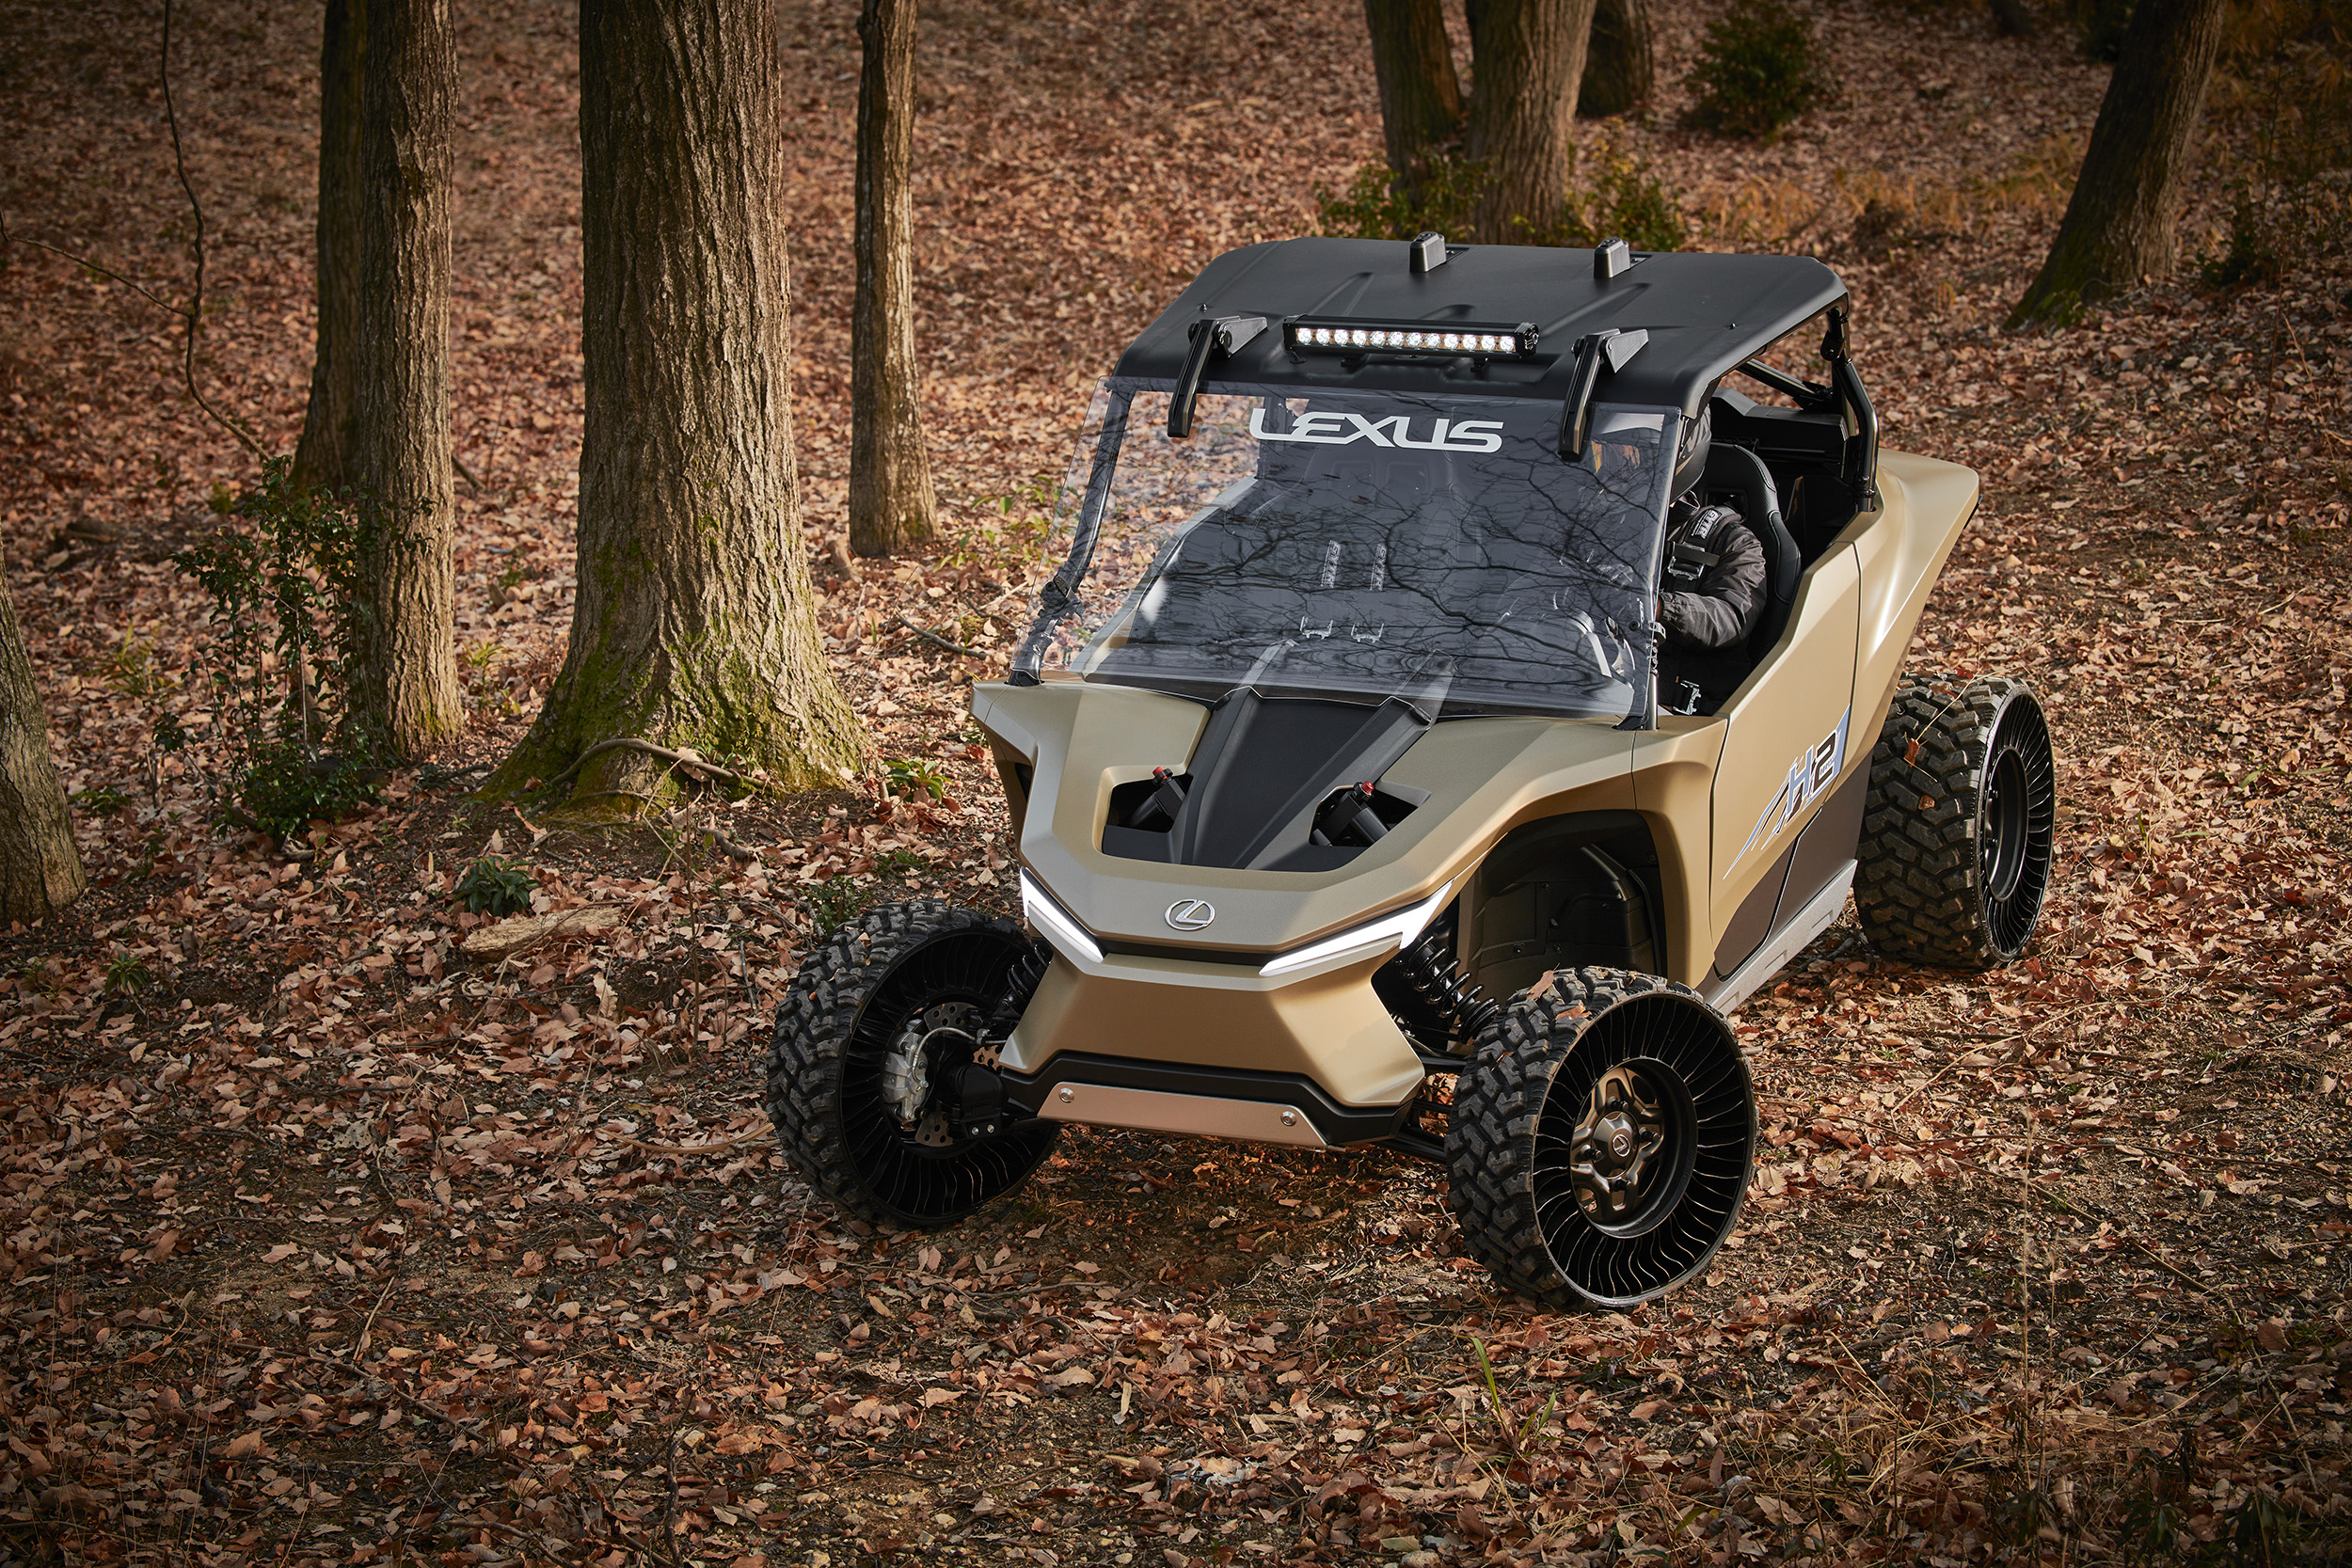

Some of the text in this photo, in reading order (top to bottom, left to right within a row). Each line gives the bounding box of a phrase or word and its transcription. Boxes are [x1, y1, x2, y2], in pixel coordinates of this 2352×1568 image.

[1249, 408, 1503, 453] LEXUS
[1695, 509, 1719, 539] GYTR
[1784, 729, 1837, 818] H2
